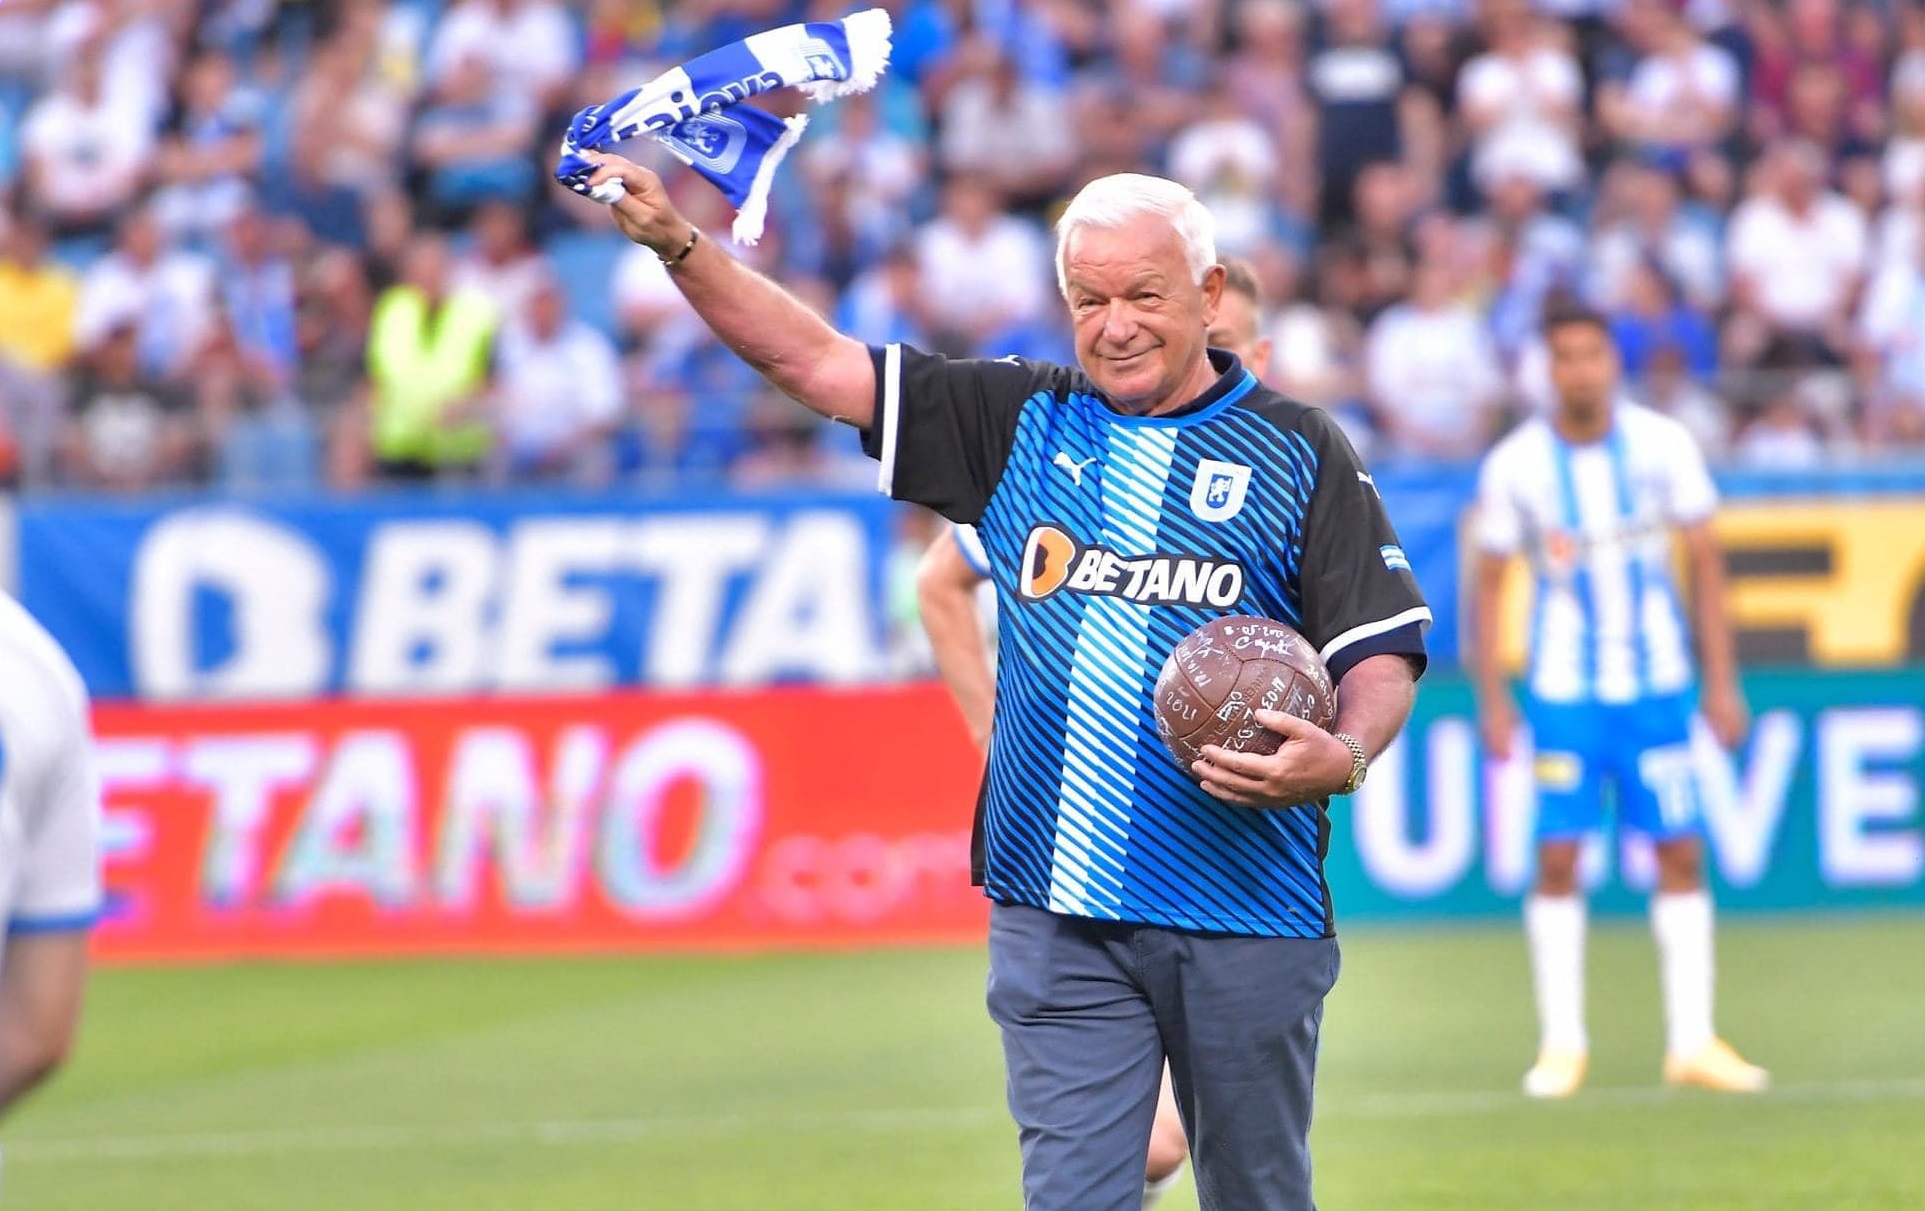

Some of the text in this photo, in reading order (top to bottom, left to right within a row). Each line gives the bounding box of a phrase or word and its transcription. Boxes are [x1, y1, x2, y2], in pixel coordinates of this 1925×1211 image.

[346, 511, 884, 694] BETA
[1066, 547, 1244, 608] BETANO
[1352, 707, 1923, 897] UVE
